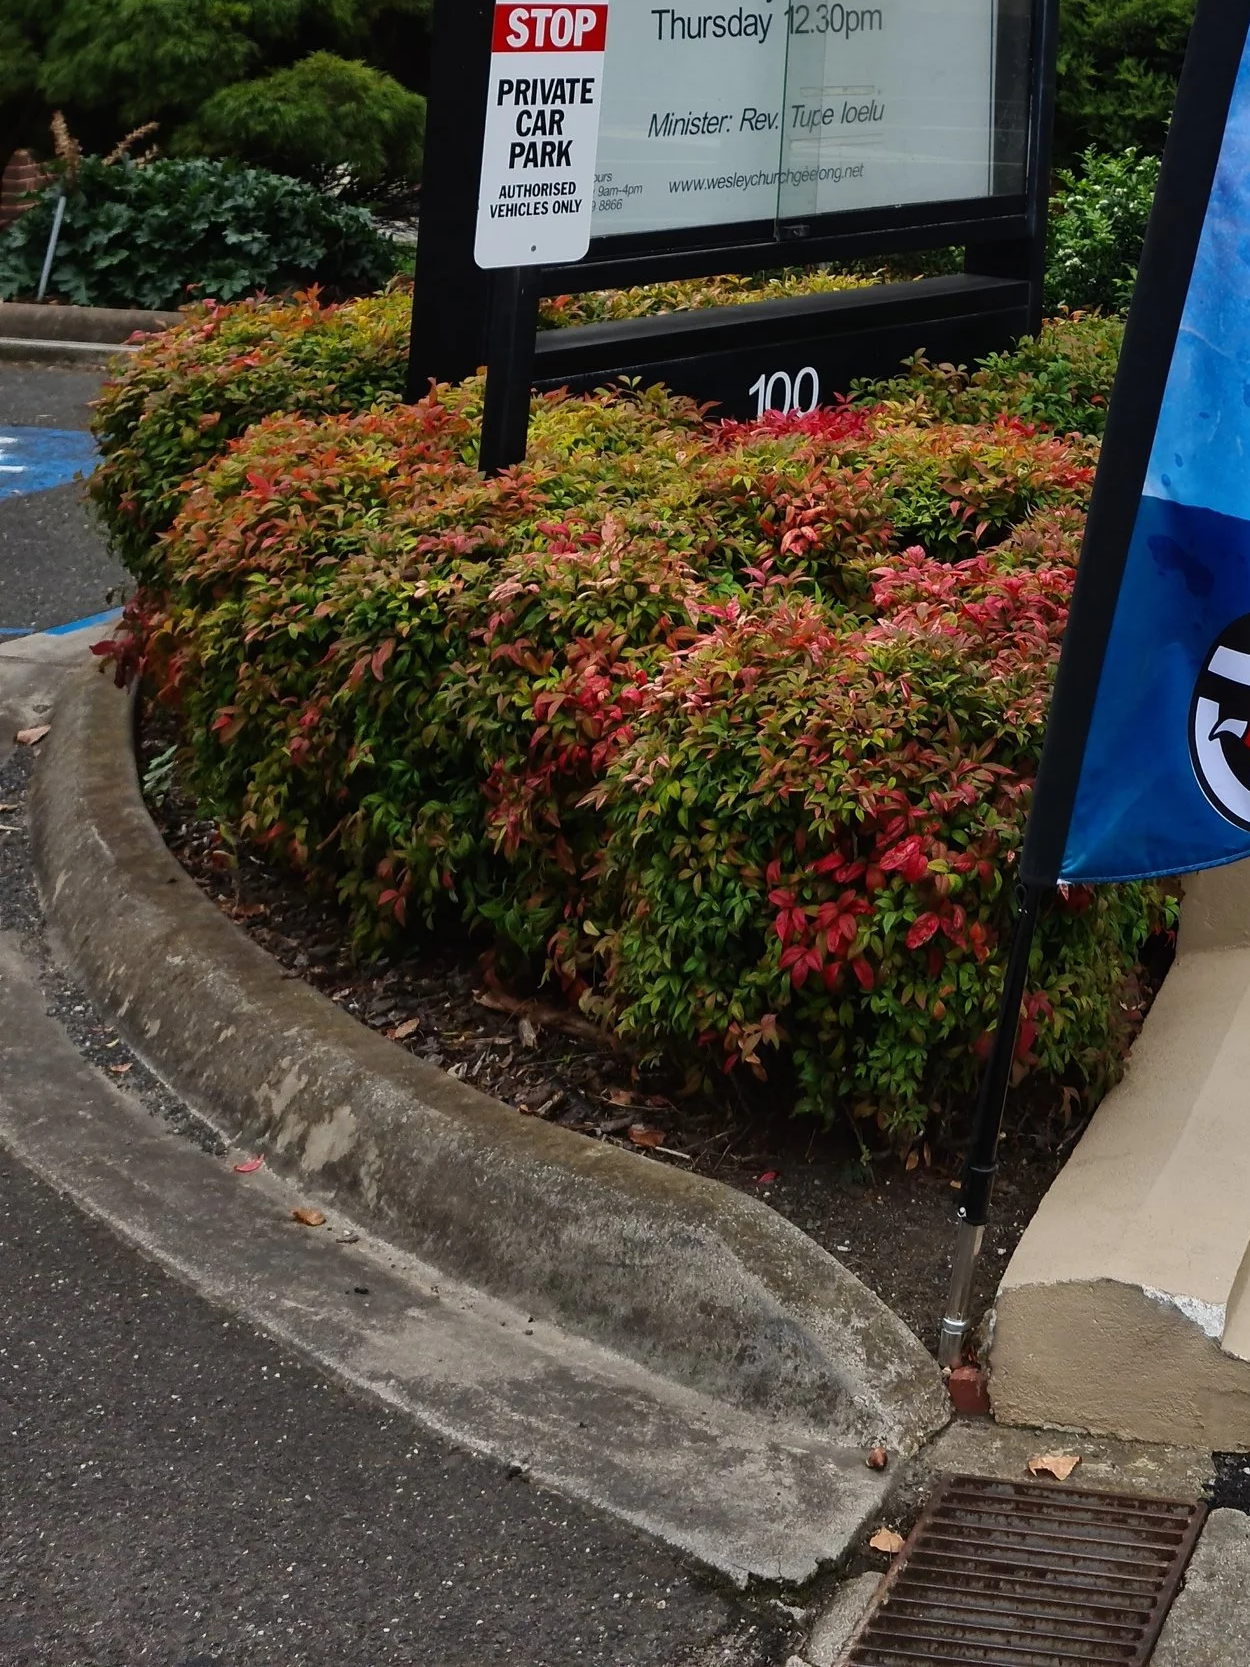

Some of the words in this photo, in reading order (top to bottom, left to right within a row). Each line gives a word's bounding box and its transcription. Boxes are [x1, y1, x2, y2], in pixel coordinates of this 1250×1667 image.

[505, 7, 597, 48] STOP
[651, 7, 772, 44] Thursday
[784, 3, 883, 37] 12.30pm
[497, 77, 595, 106] PRIVATE
[516, 109, 565, 137] CAR
[647, 111, 733, 138] Minister:
[740, 107, 779, 132] Rev.
[508, 140, 573, 169] PARK
[498, 181, 577, 200] AUTHORISED
[598, 183, 643, 198] 9am-4pm
[668, 163, 865, 194] www.wesleychurchgeelong.net
[489, 200, 549, 219] VEHICLES
[552, 199, 583, 215] ONLY
[598, 198, 623, 212] 8866
[749, 366, 820, 424] 100
